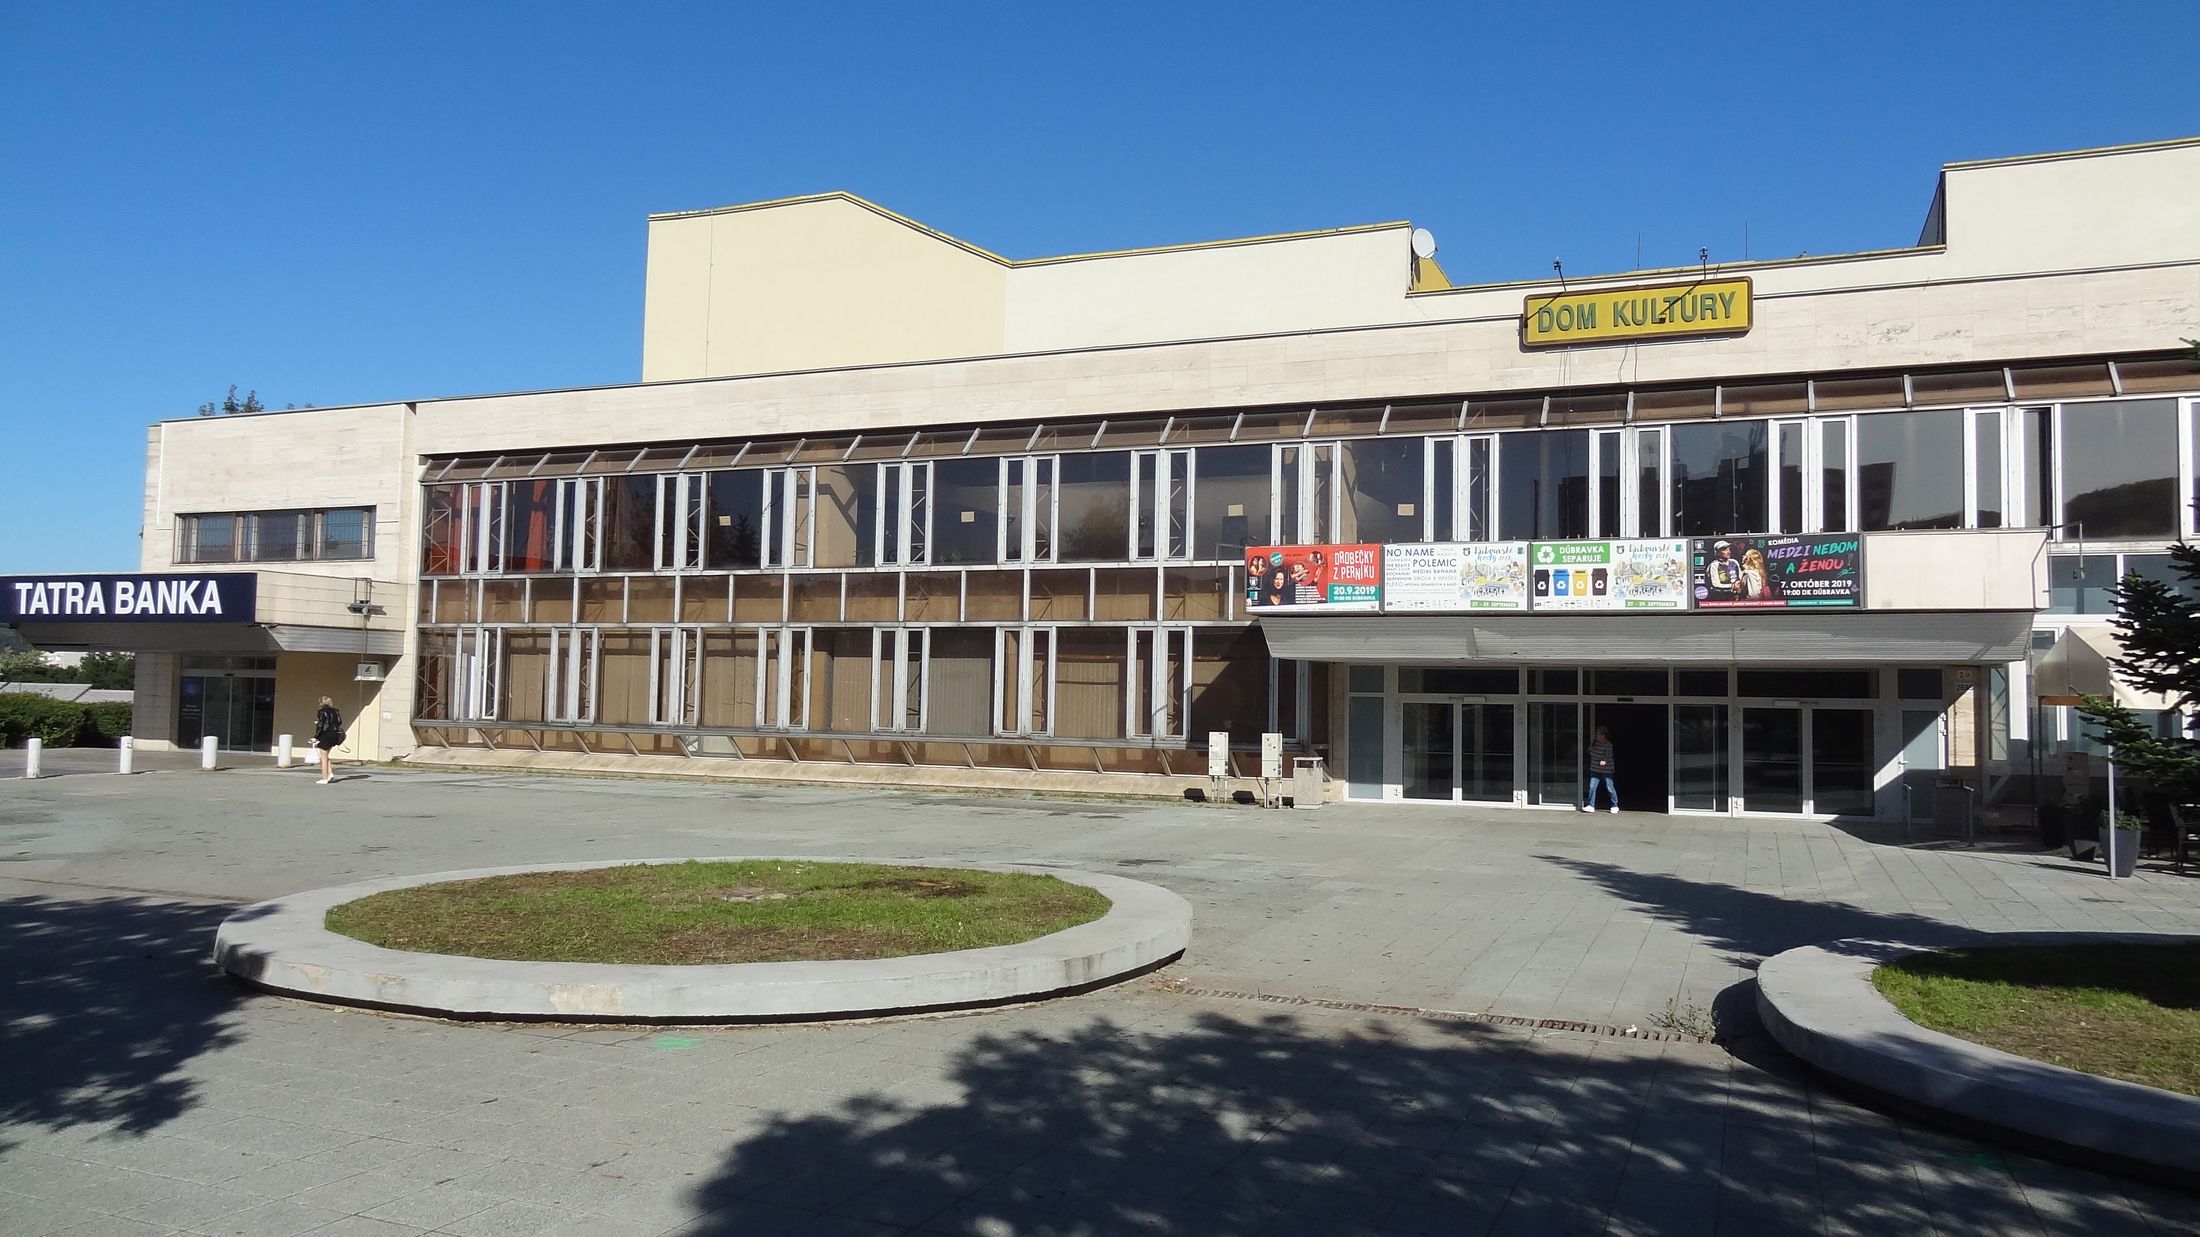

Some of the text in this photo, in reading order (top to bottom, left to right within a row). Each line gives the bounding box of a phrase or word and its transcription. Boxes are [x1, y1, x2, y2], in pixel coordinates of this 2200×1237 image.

[1537, 302, 1597, 333] DOM
[1768, 537, 1799, 546] KOMÉDIA
[1386, 548, 1402, 557] NO
[1405, 548, 1435, 556] NAME
[1559, 545, 1604, 554] DÚBRAVKA
[1767, 541, 1858, 559] MEDZI NEBOM
[1334, 549, 1374, 565] DROBEČKY
[1562, 555, 1602, 563] SEPARUJE
[1413, 558, 1457, 567] POLEMIC
[1786, 559, 1844, 574] A ŽENOU
[1333, 565, 1375, 580] Z PERNÍKU
[1790, 579, 1830, 588] OKTÓBER
[1831, 580, 1852, 588] 2019
[1333, 586, 1375, 595] 20.9.2019
[15, 580, 223, 615] TATRA BANKA
